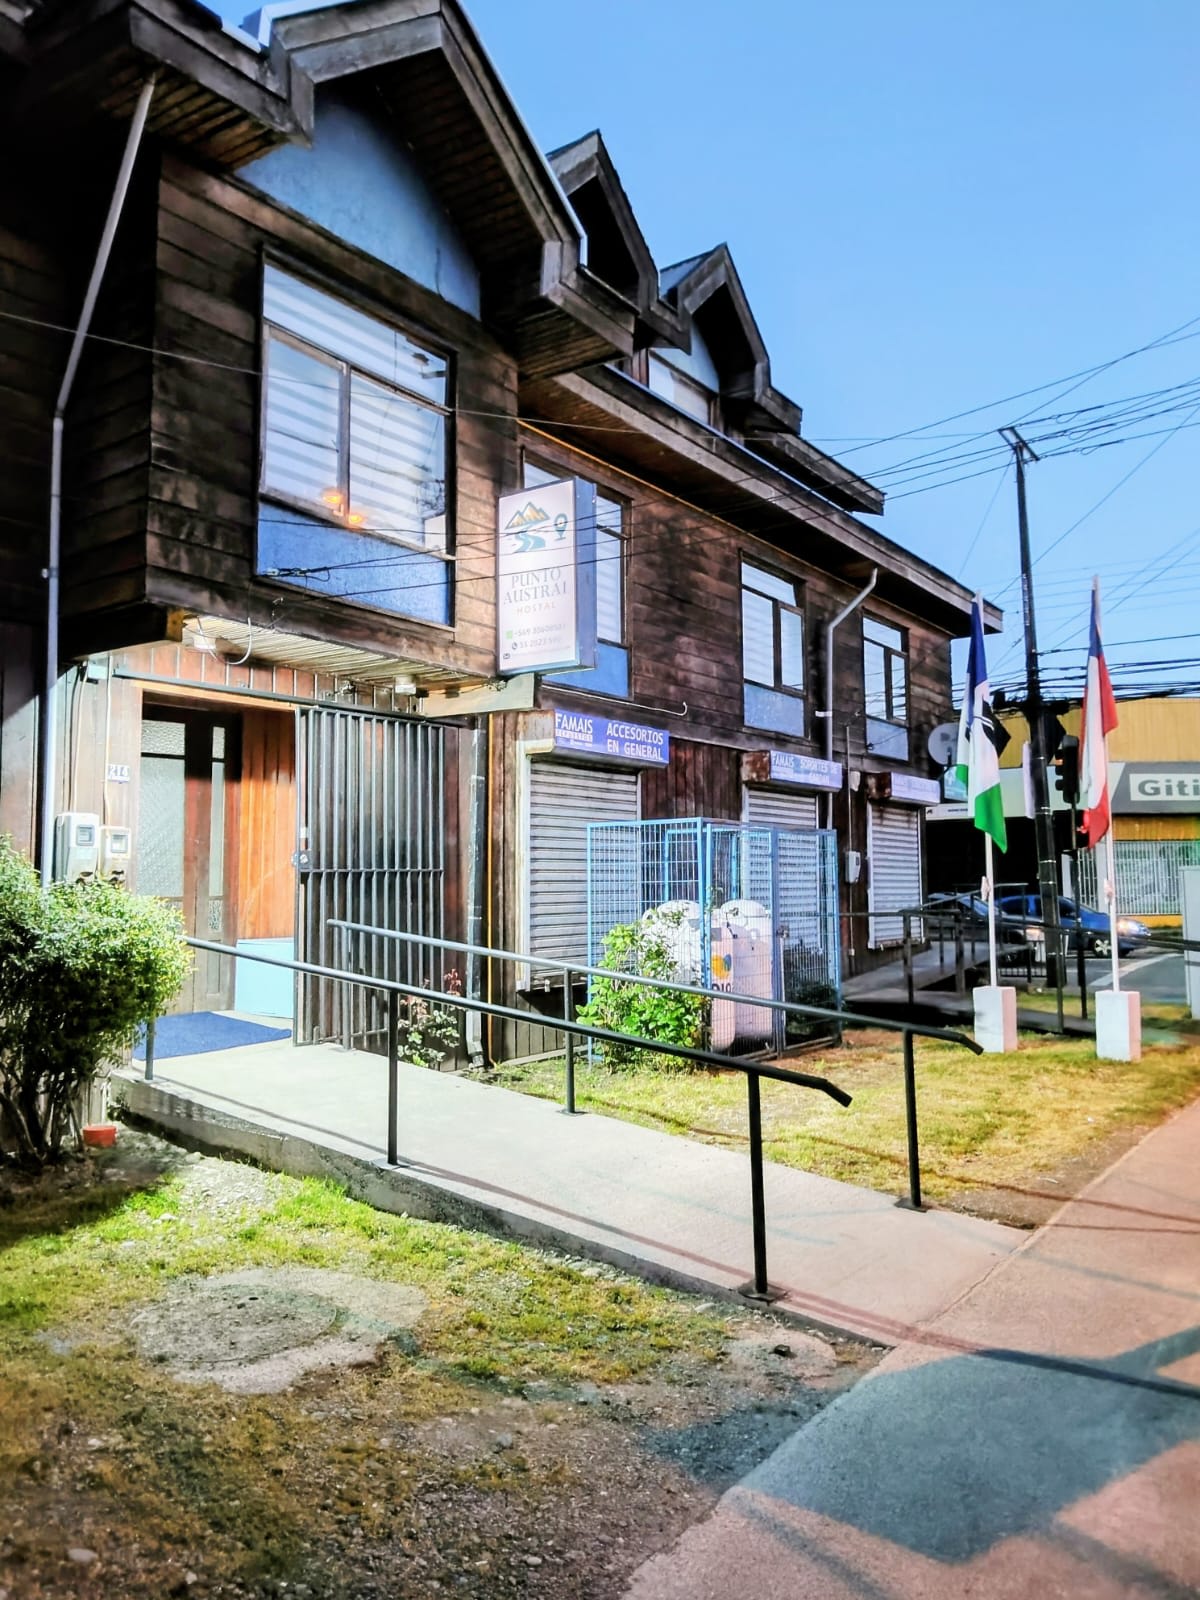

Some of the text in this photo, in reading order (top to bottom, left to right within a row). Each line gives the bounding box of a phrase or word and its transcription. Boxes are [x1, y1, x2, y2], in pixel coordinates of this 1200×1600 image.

[555, 713, 593, 734] FAMAIS
[606, 722, 664, 745] ACCESORIOS
[607, 739, 619, 753] EN
[624, 742, 663, 760] GENERAL
[1137, 778, 1200, 796] Giti
